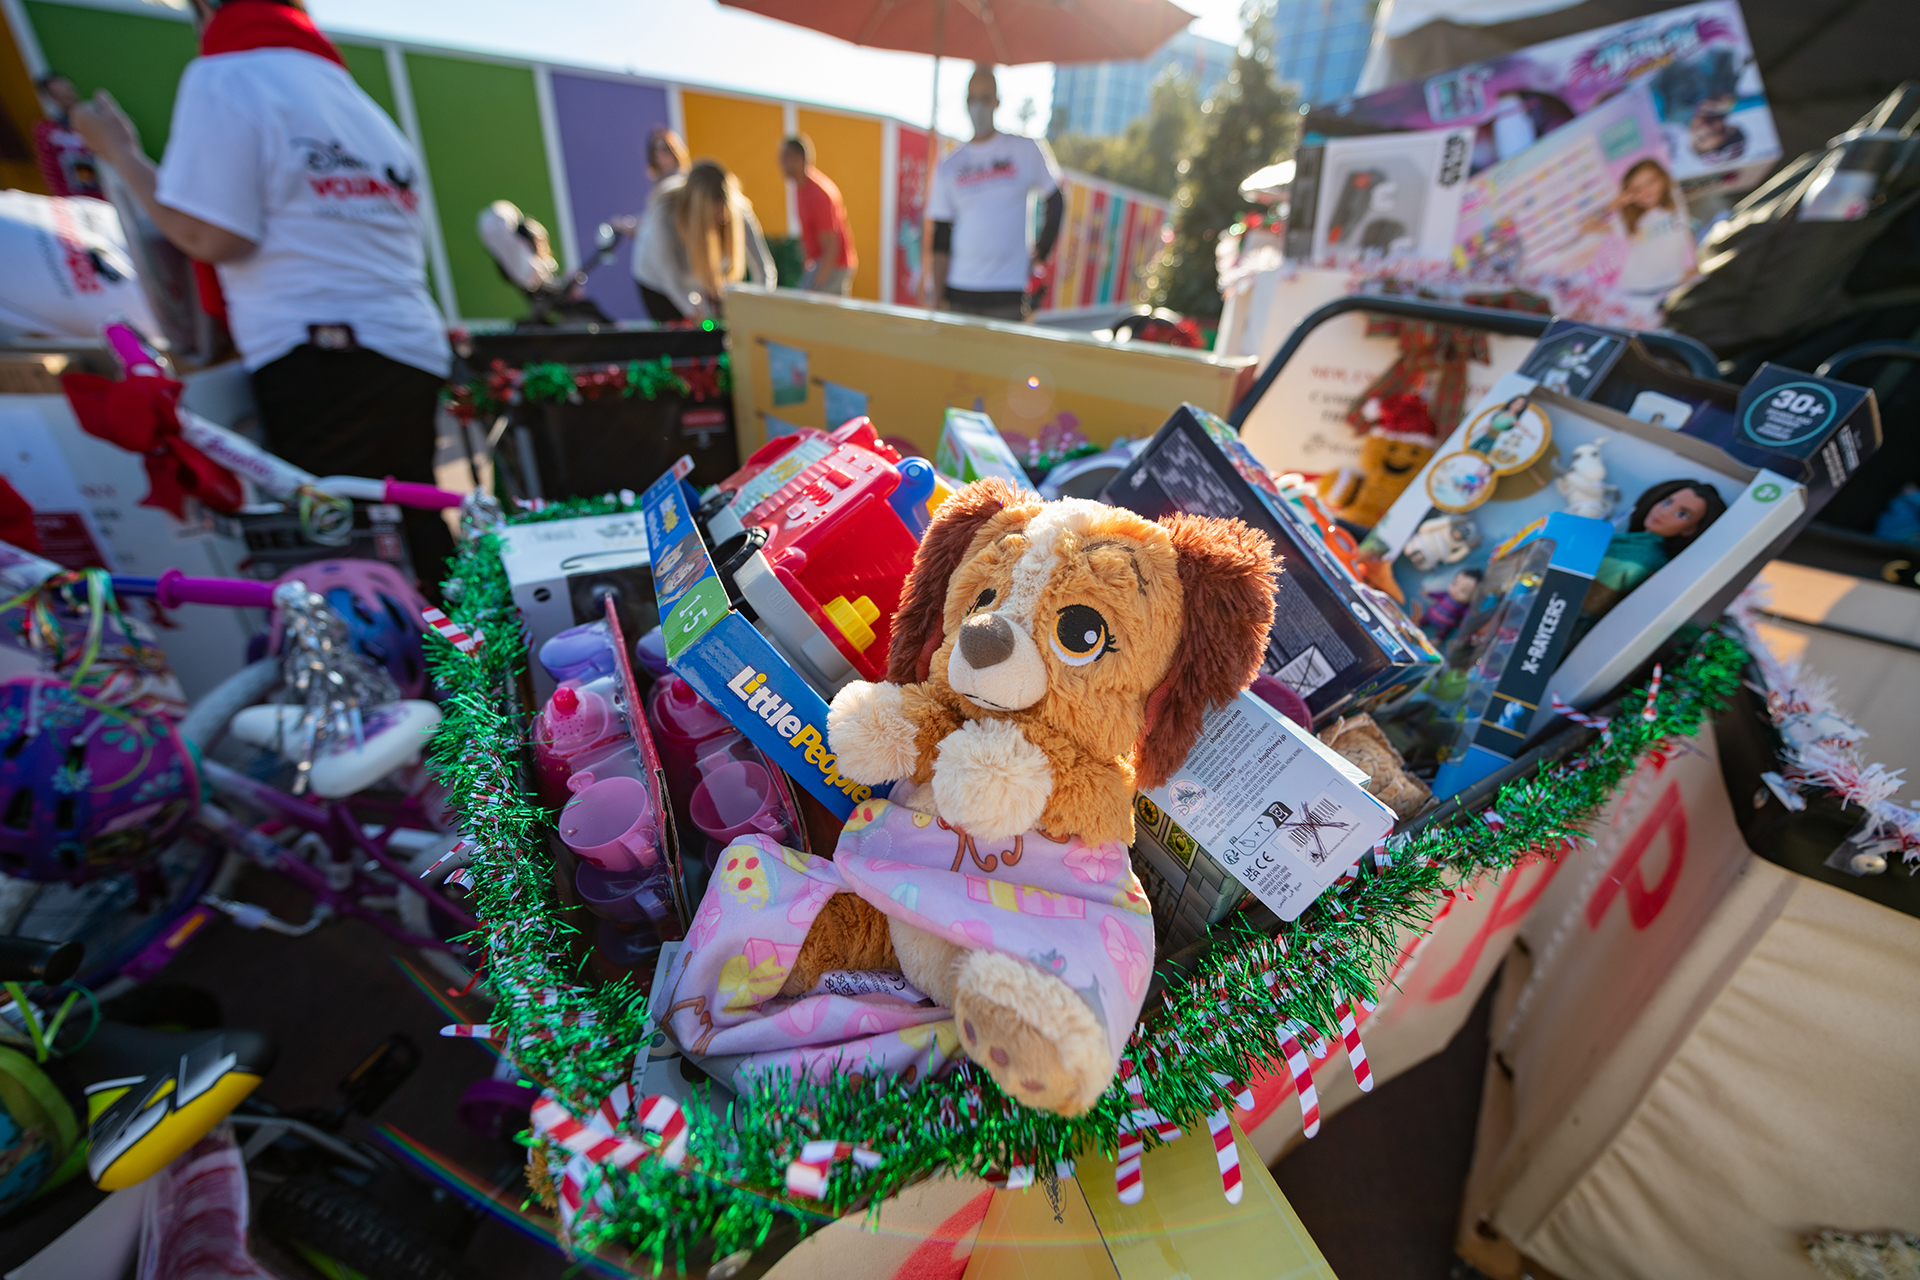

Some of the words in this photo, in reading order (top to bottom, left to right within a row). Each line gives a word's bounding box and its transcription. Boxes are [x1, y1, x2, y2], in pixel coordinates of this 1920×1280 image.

[1771, 389, 1825, 417] 30+
[679, 594, 708, 633] 1-5
[1521, 598, 1567, 675] X-RAYCERS
[727, 665, 801, 738] Little
[1207, 708, 1243, 745] shopDisney.com
[1255, 731, 1288, 765] shopDisney.jp
[1242, 864, 1254, 877] UK
[1253, 850, 1274, 871] CE
